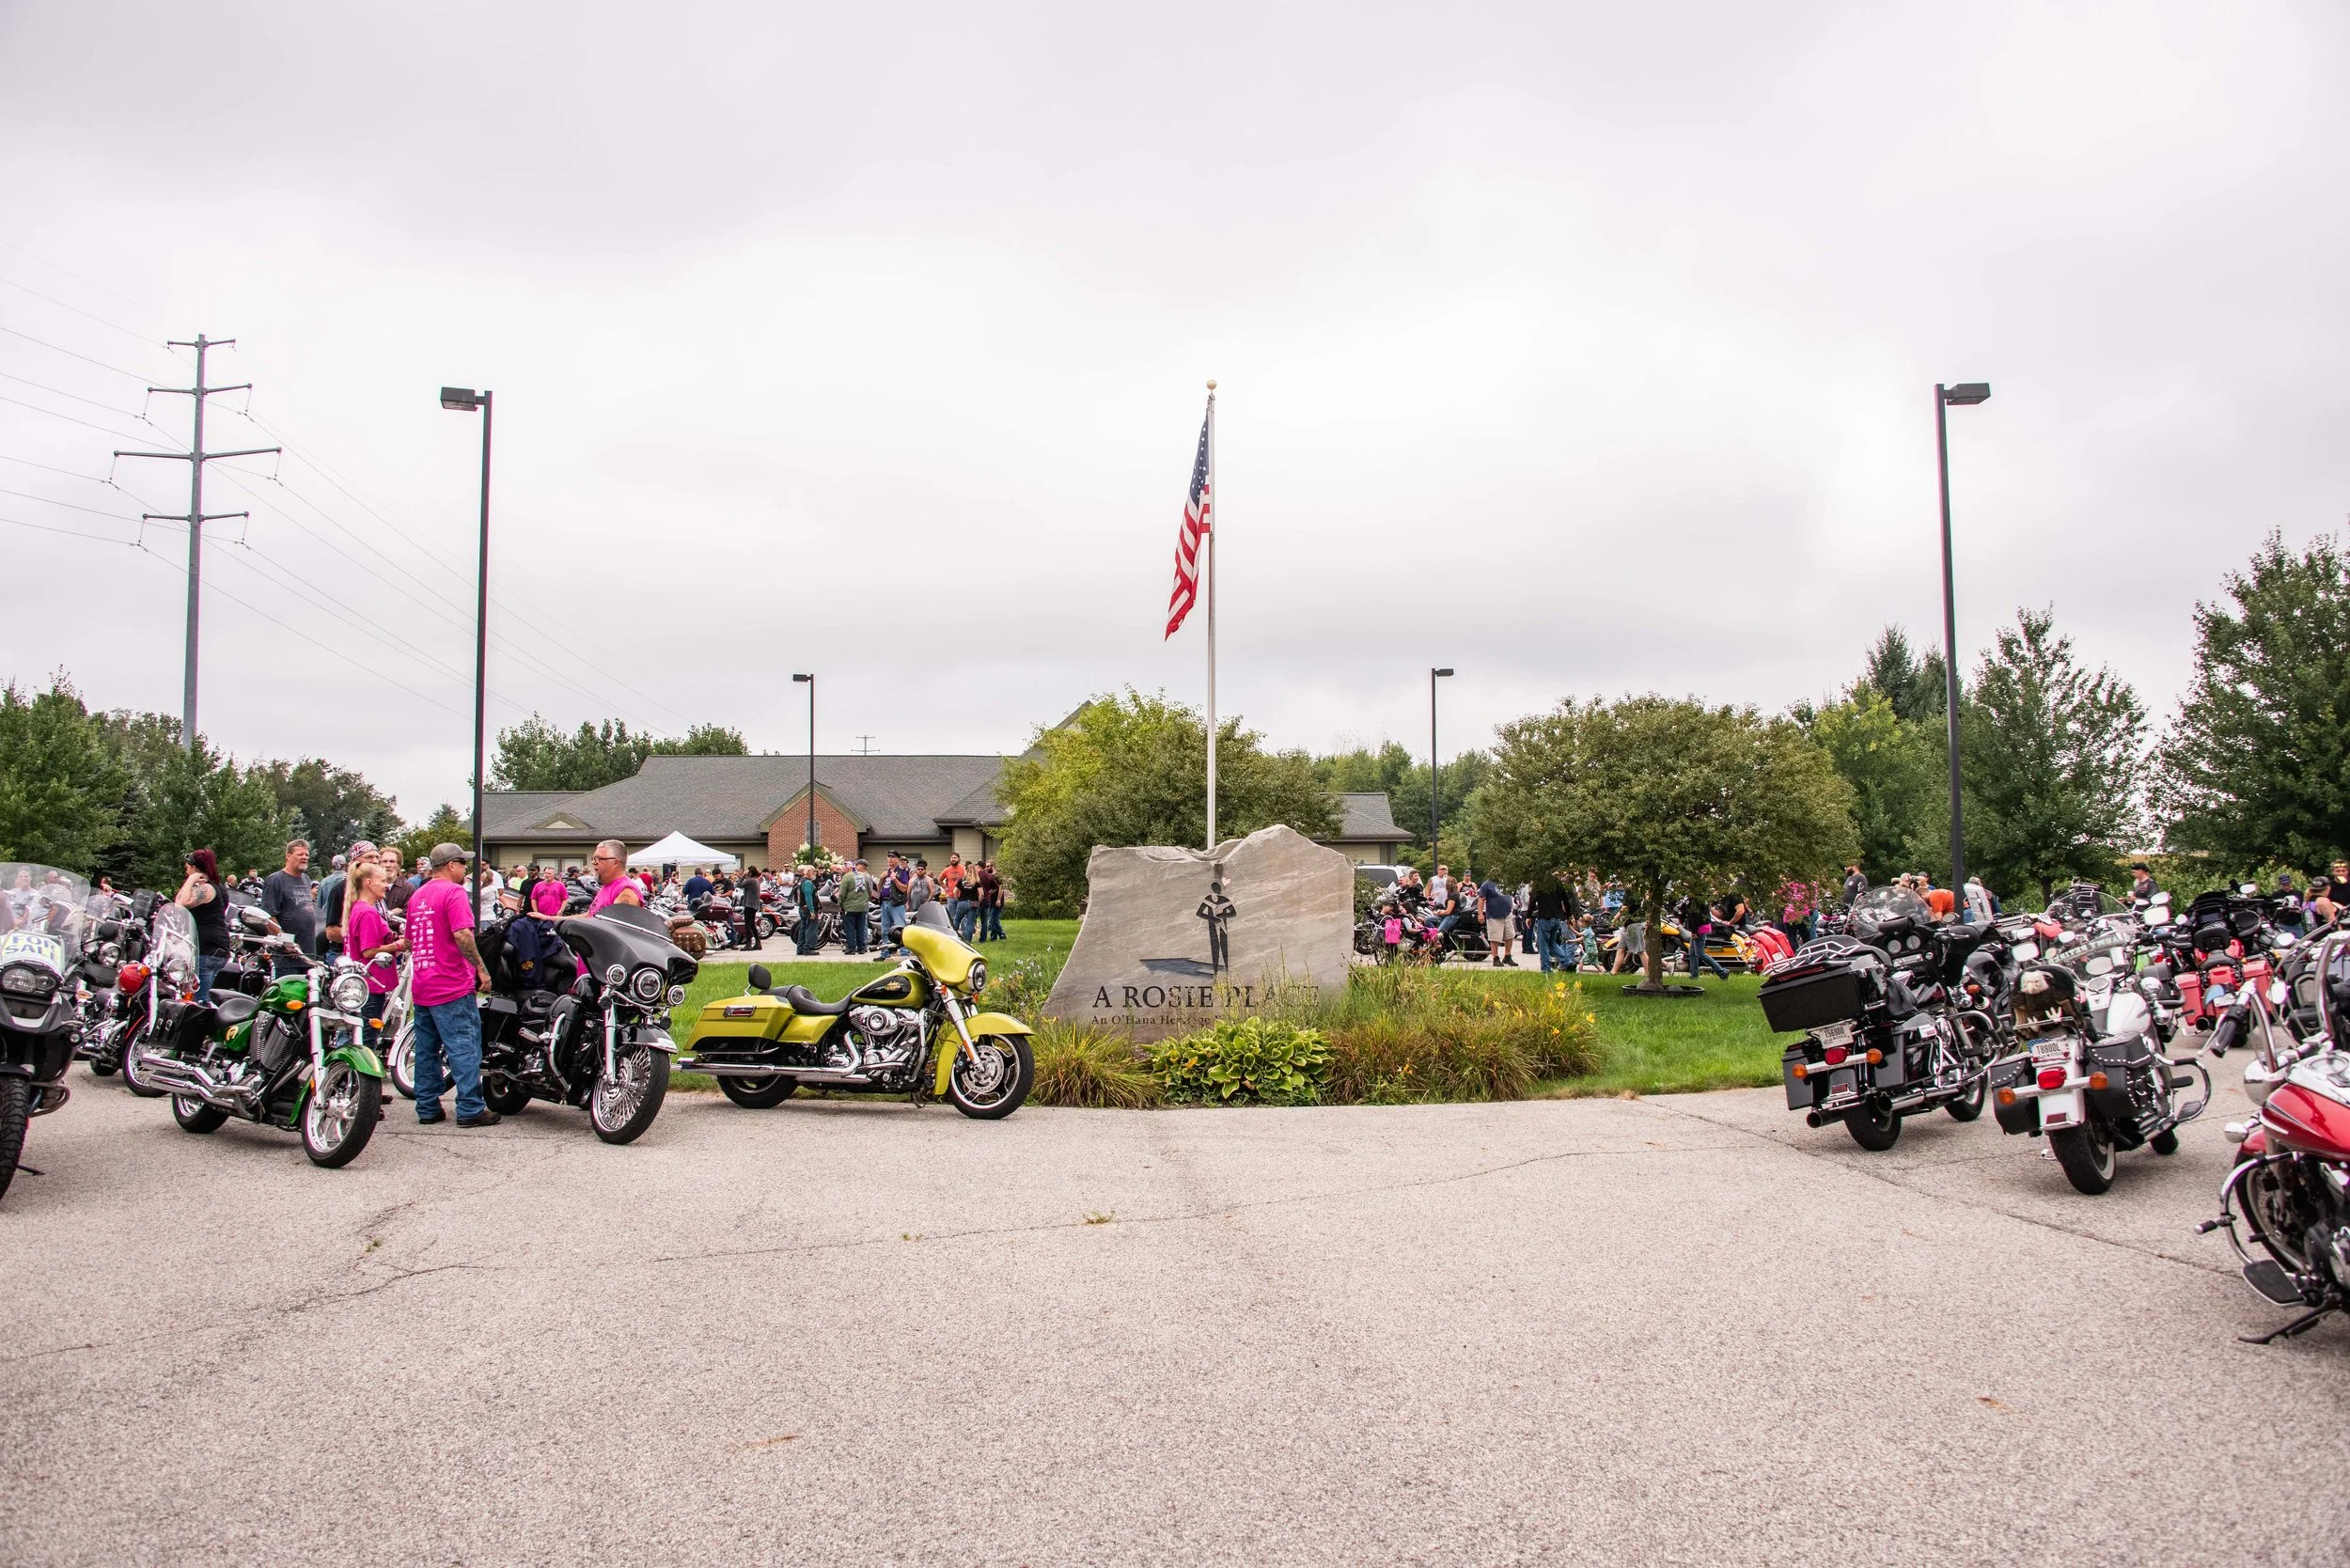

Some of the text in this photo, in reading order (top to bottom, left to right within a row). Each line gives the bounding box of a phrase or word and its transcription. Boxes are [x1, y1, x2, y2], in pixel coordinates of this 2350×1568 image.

[13, 936, 55, 951] FOR
[5, 944, 58, 962] SALE
[1092, 985, 1319, 1008] A ROSIE PLA
[1091, 1015, 1107, 1025] An
[1111, 1014, 1155, 1025] O'Hana
